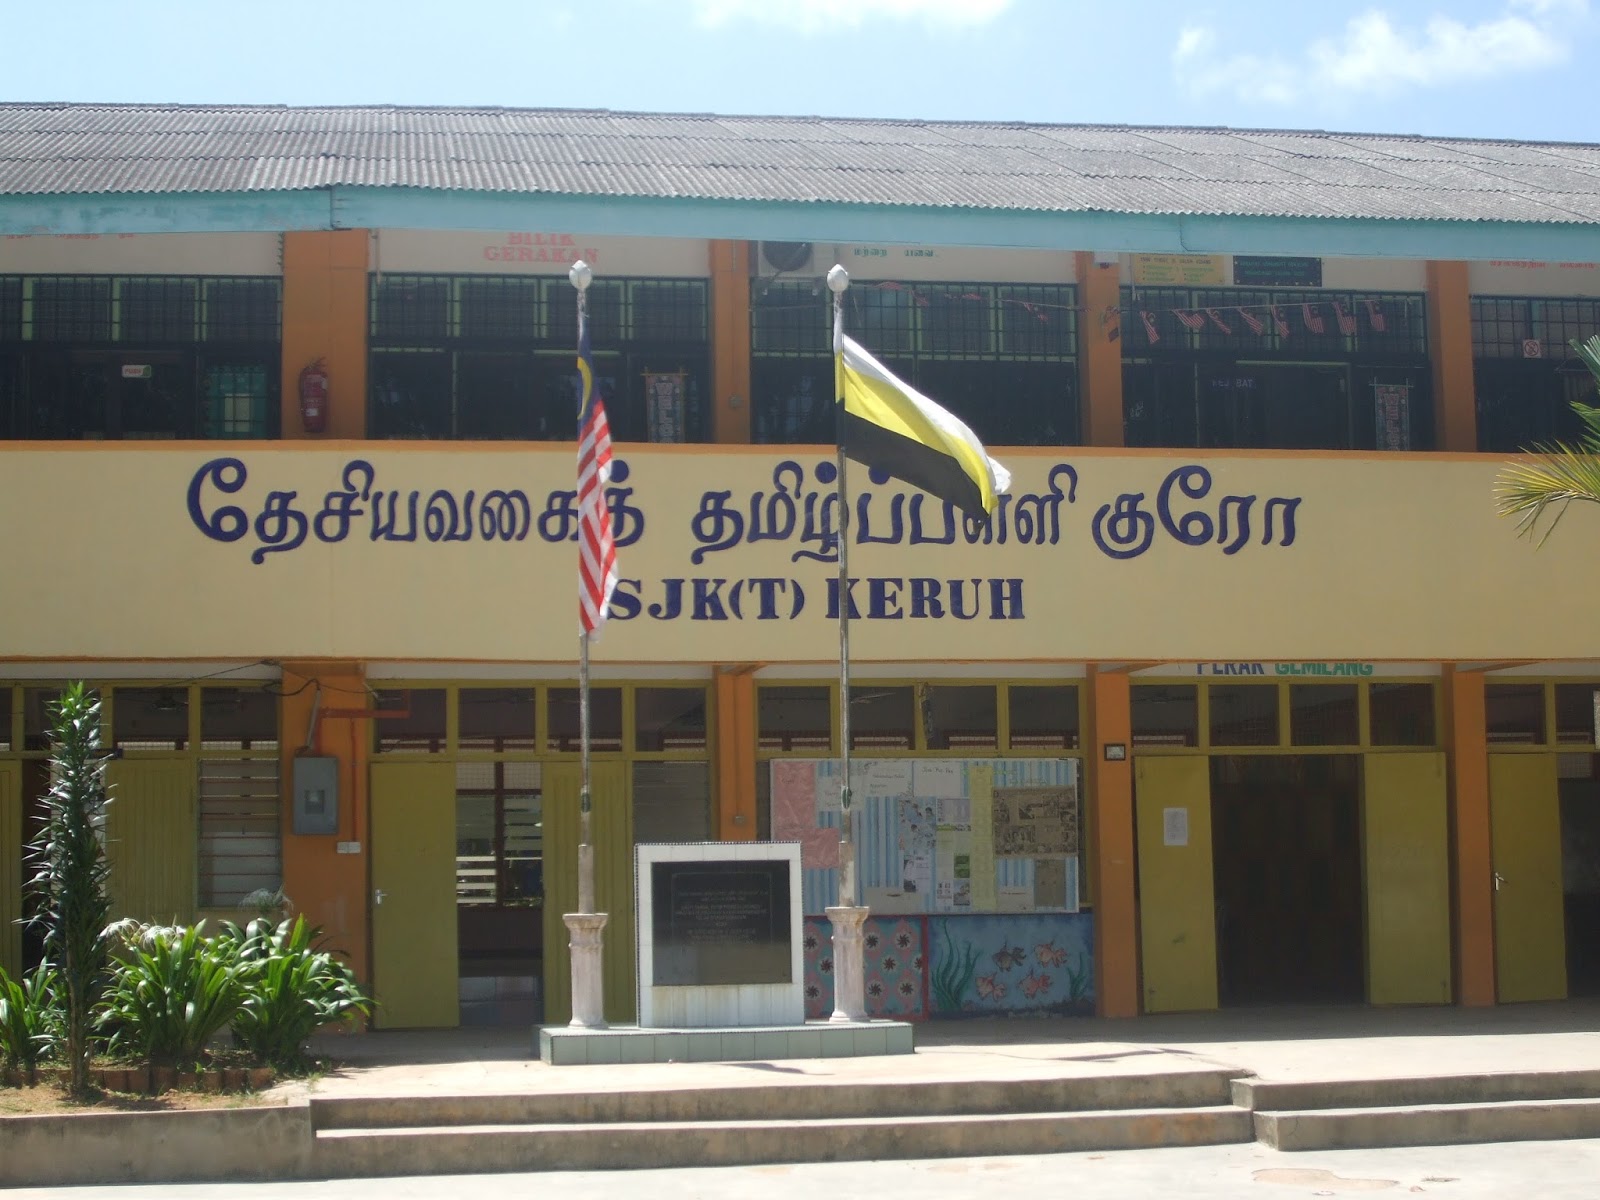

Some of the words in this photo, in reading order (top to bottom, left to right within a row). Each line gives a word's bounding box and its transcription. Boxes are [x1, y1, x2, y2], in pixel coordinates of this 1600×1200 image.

[507, 232, 575, 246] BILIK
[483, 246, 600, 264] GERAKAN
[1092, 465, 1302, 560] குரோ
[606, 578, 805, 620] SJK(T)
[825, 578, 1025, 620] KERUH
[1275, 662, 1373, 676] GEMILANG
